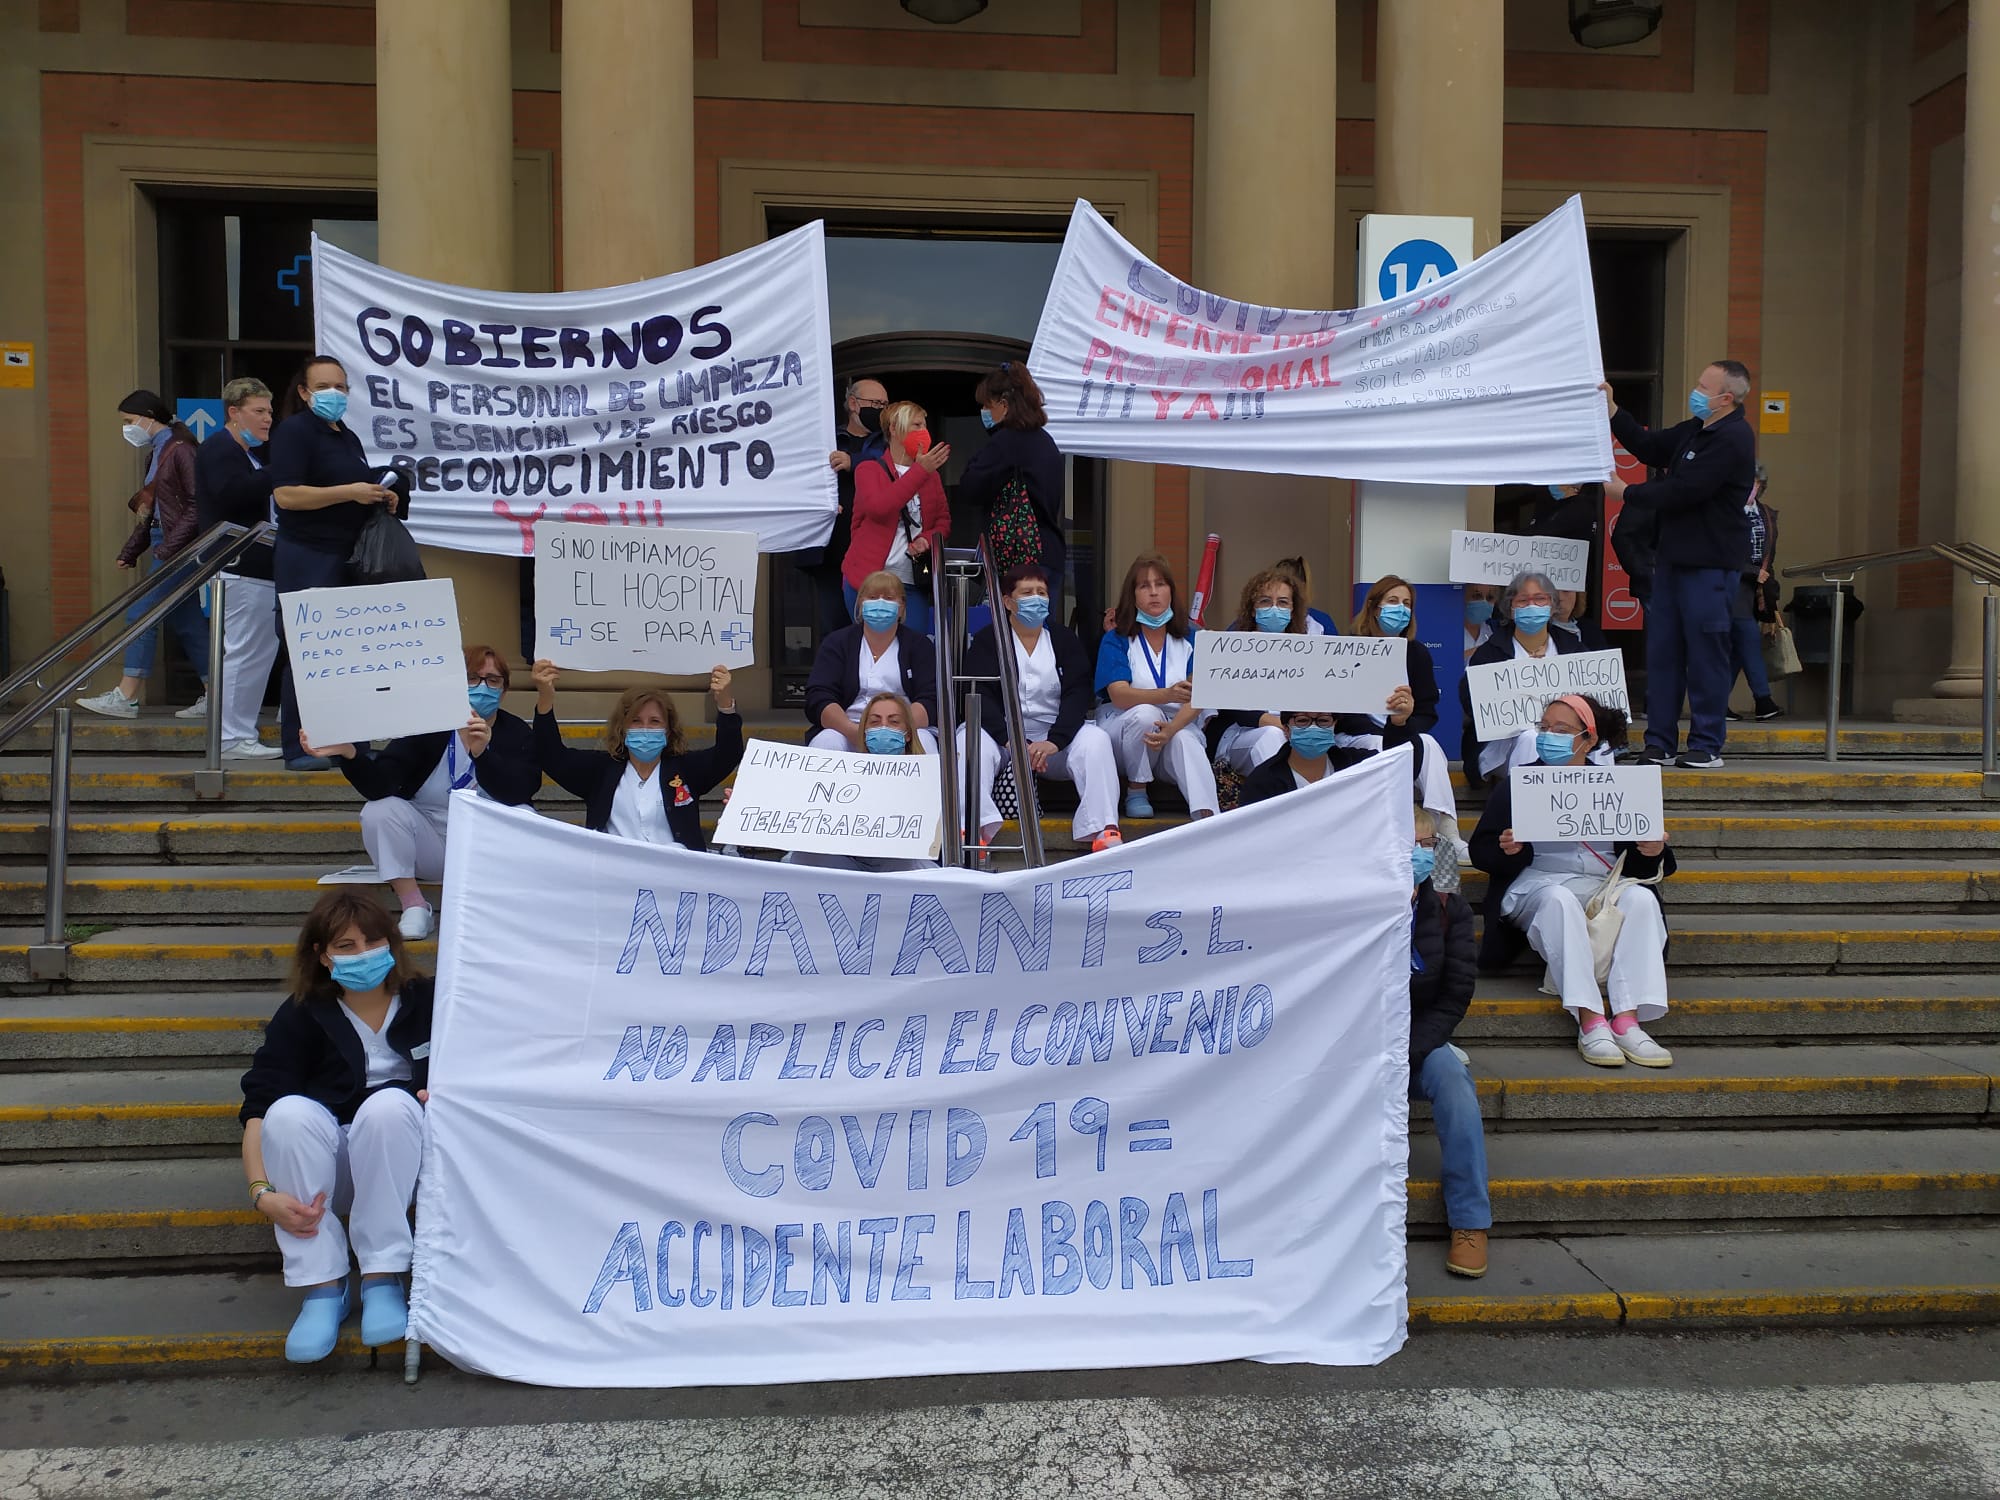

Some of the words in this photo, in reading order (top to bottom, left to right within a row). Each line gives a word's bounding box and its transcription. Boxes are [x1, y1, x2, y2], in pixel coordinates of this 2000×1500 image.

[1359, 292, 1517, 348] TRABAJADORES
[356, 305, 732, 369] GOBIERNOS
[365, 374, 414, 412] EL
[428, 379, 598, 418] PERSONAL
[608, 380, 647, 412] DE
[657, 350, 804, 410] LIMPIEZA
[1355, 368, 1426, 393] SOLO
[1440, 362, 1471, 379] EN
[371, 414, 418, 451] ES
[431, 419, 577, 454] ESENCIAL
[619, 416, 657, 441] DE
[671, 400, 773, 436] RIESGO
[388, 440, 776, 498] RECONOCIMIENTO
[550, 533, 567, 560] SI
[572, 538, 596, 560] NO
[601, 536, 717, 570] LIMPIAMOS
[1463, 536, 1521, 556] MISMO
[1530, 541, 1580, 561] RIESGO
[1542, 562, 1581, 583] TRATO
[574, 570, 607, 608] EL
[622, 572, 754, 616] HOSPITAL
[335, 602, 407, 620] SOMOS
[299, 616, 448, 643] FUNCIONARIOS
[590, 621, 619, 642] SE
[644, 620, 716, 645] PARA
[302, 647, 344, 661] PERO
[360, 639, 425, 654] SOMOS
[1210, 637, 1316, 657] NOSOTROS
[1322, 637, 1393, 660] TAMBIÉN
[305, 654, 446, 681] NECESARIOS
[1208, 666, 1307, 682] TRABAJAMOS
[1494, 663, 1560, 691] MISMO
[1568, 657, 1620, 688] RIESGO
[1479, 696, 1537, 729] MISMO
[749, 747, 848, 774] LIMPIEZA
[852, 758, 922, 779] SANITARIA
[1522, 771, 1545, 785] SIN
[1551, 770, 1616, 785] LIMPIEZA
[807, 781, 862, 804] NO
[1551, 792, 1579, 812] NO
[1593, 791, 1624, 812] HAY
[739, 806, 924, 840] TELETRABAJA
[1557, 812, 1652, 837] SALUD
[615, 869, 1134, 977] NDAVANT
[603, 1024, 689, 1082] NO
[691, 1016, 928, 1082] APLICA
[939, 1008, 1000, 1075] EL
[1010, 983, 1274, 1067] CONVENIO
[721, 1106, 988, 1198] COVID
[582, 1213, 936, 1315] ACCIDENTE
[955, 1188, 1255, 1301] LABORAL
